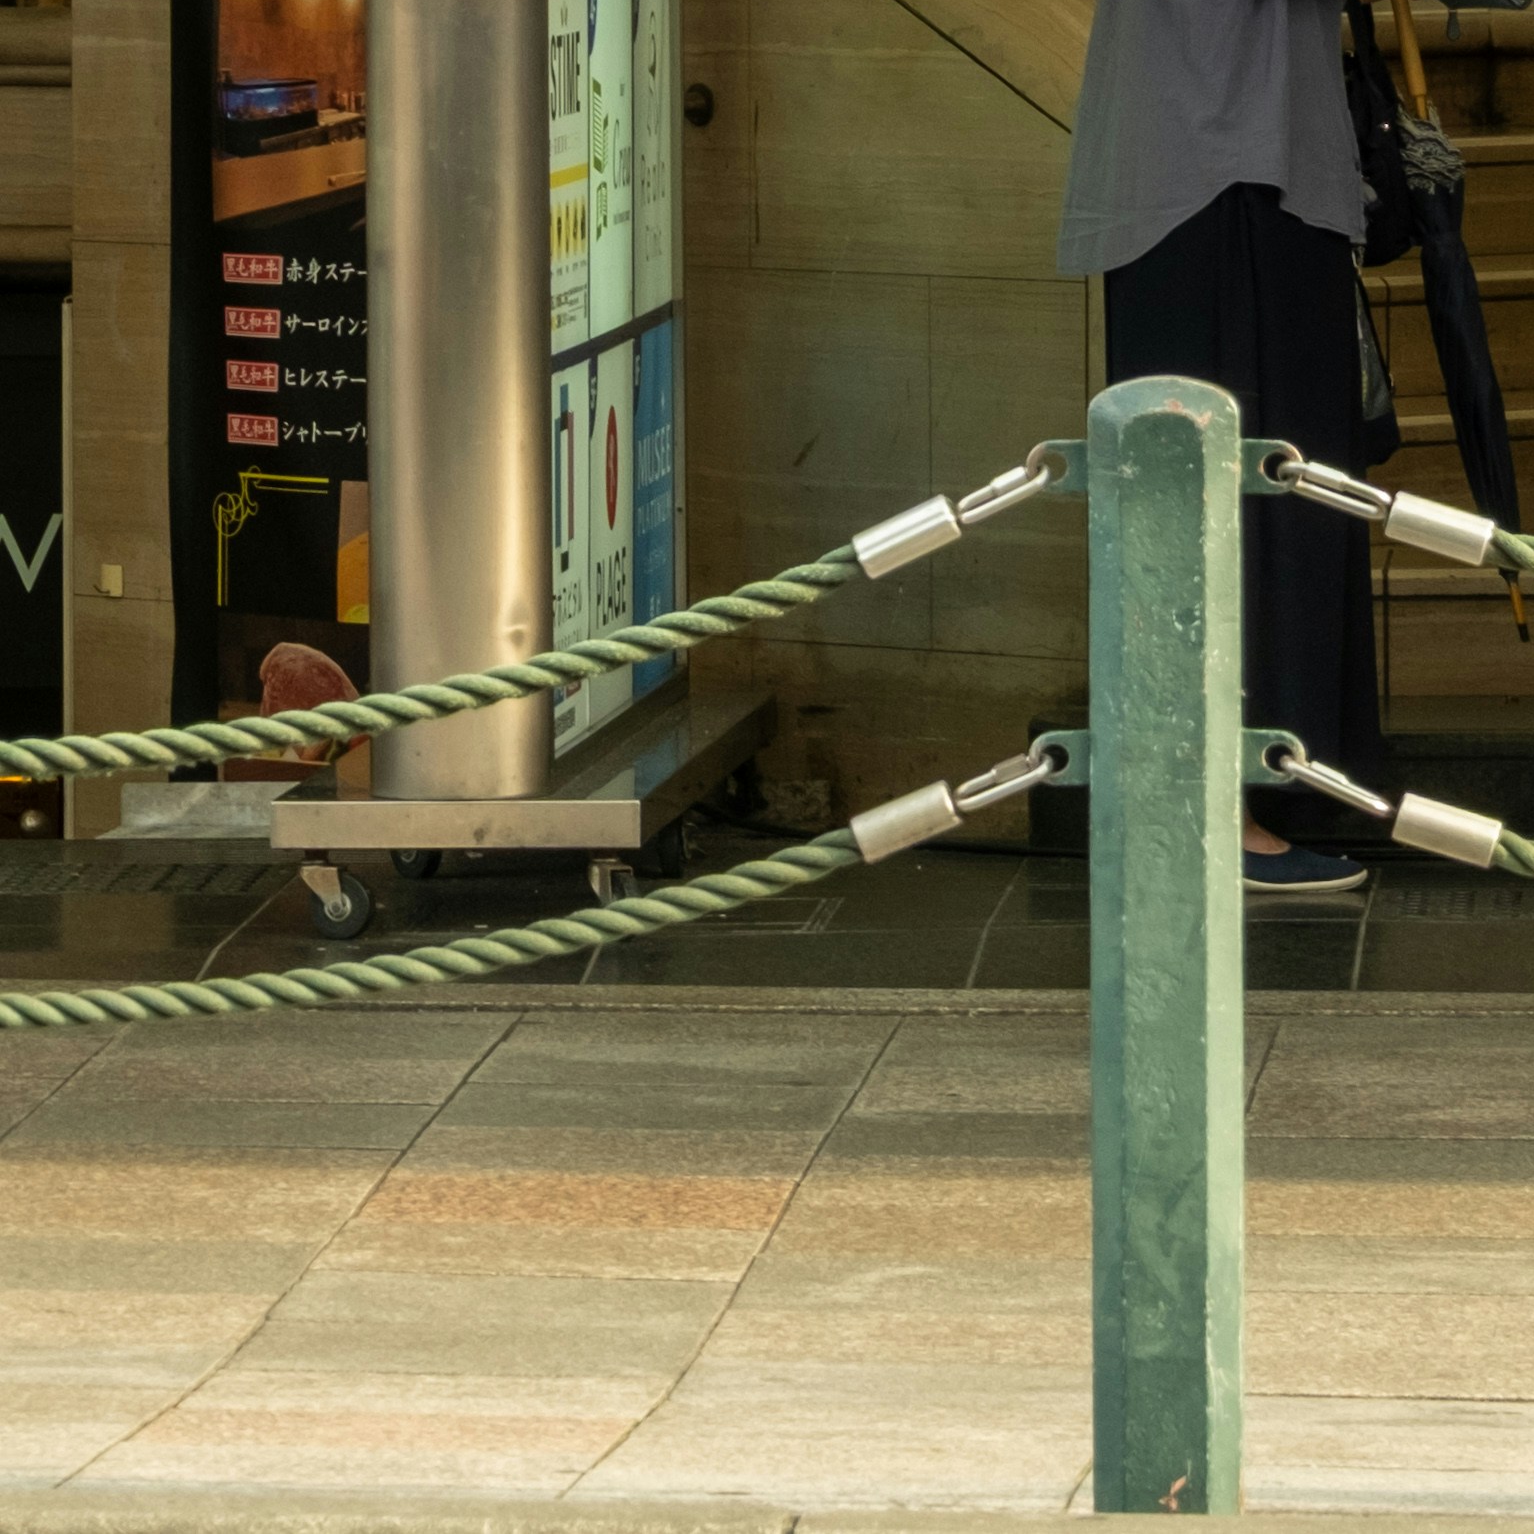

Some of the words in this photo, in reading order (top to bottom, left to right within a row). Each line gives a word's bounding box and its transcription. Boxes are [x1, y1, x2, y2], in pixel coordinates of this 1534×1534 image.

[550, 30, 581, 121] STIME
[285, 257, 367, 284] 赤身ステー
[284, 368, 367, 390] ヒレステー
[637, 423, 671, 491] MUSEE
[596, 546, 627, 630] PLAGE
